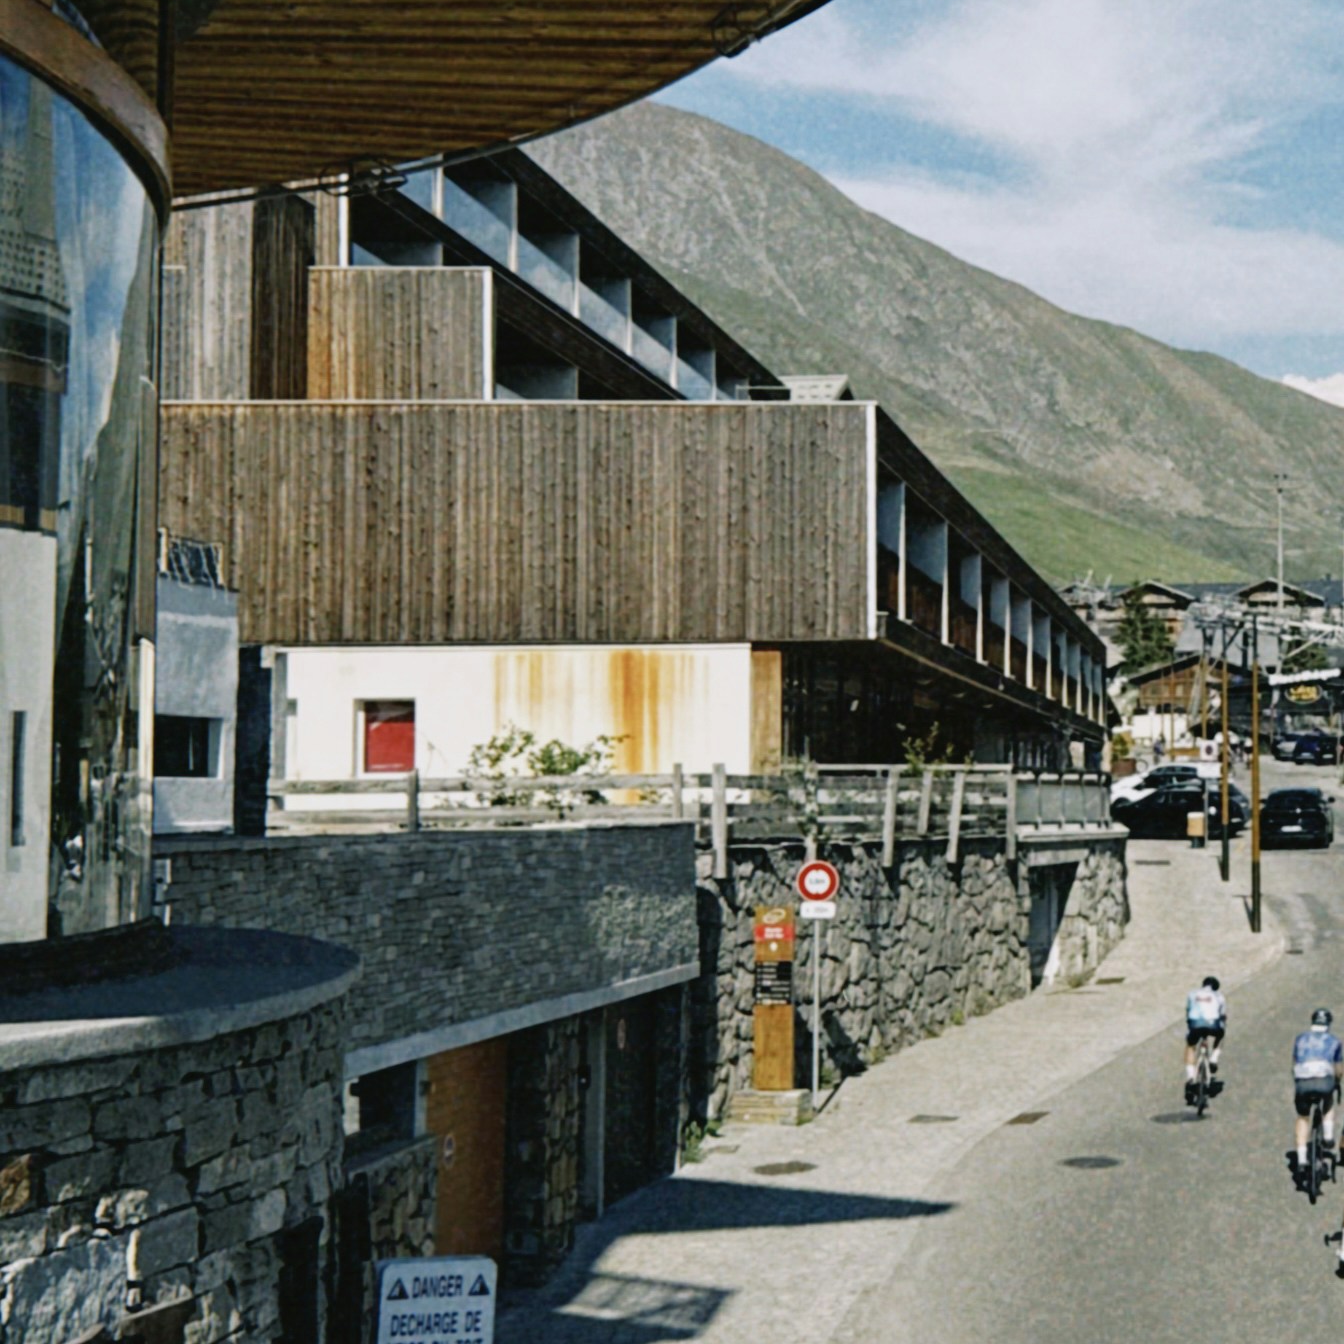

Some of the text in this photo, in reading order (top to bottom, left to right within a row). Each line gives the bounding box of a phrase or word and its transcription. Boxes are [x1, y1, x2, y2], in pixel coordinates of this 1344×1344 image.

[411, 1274, 463, 1298] DANGER
[390, 1310, 483, 1337] DECHARGE DE
